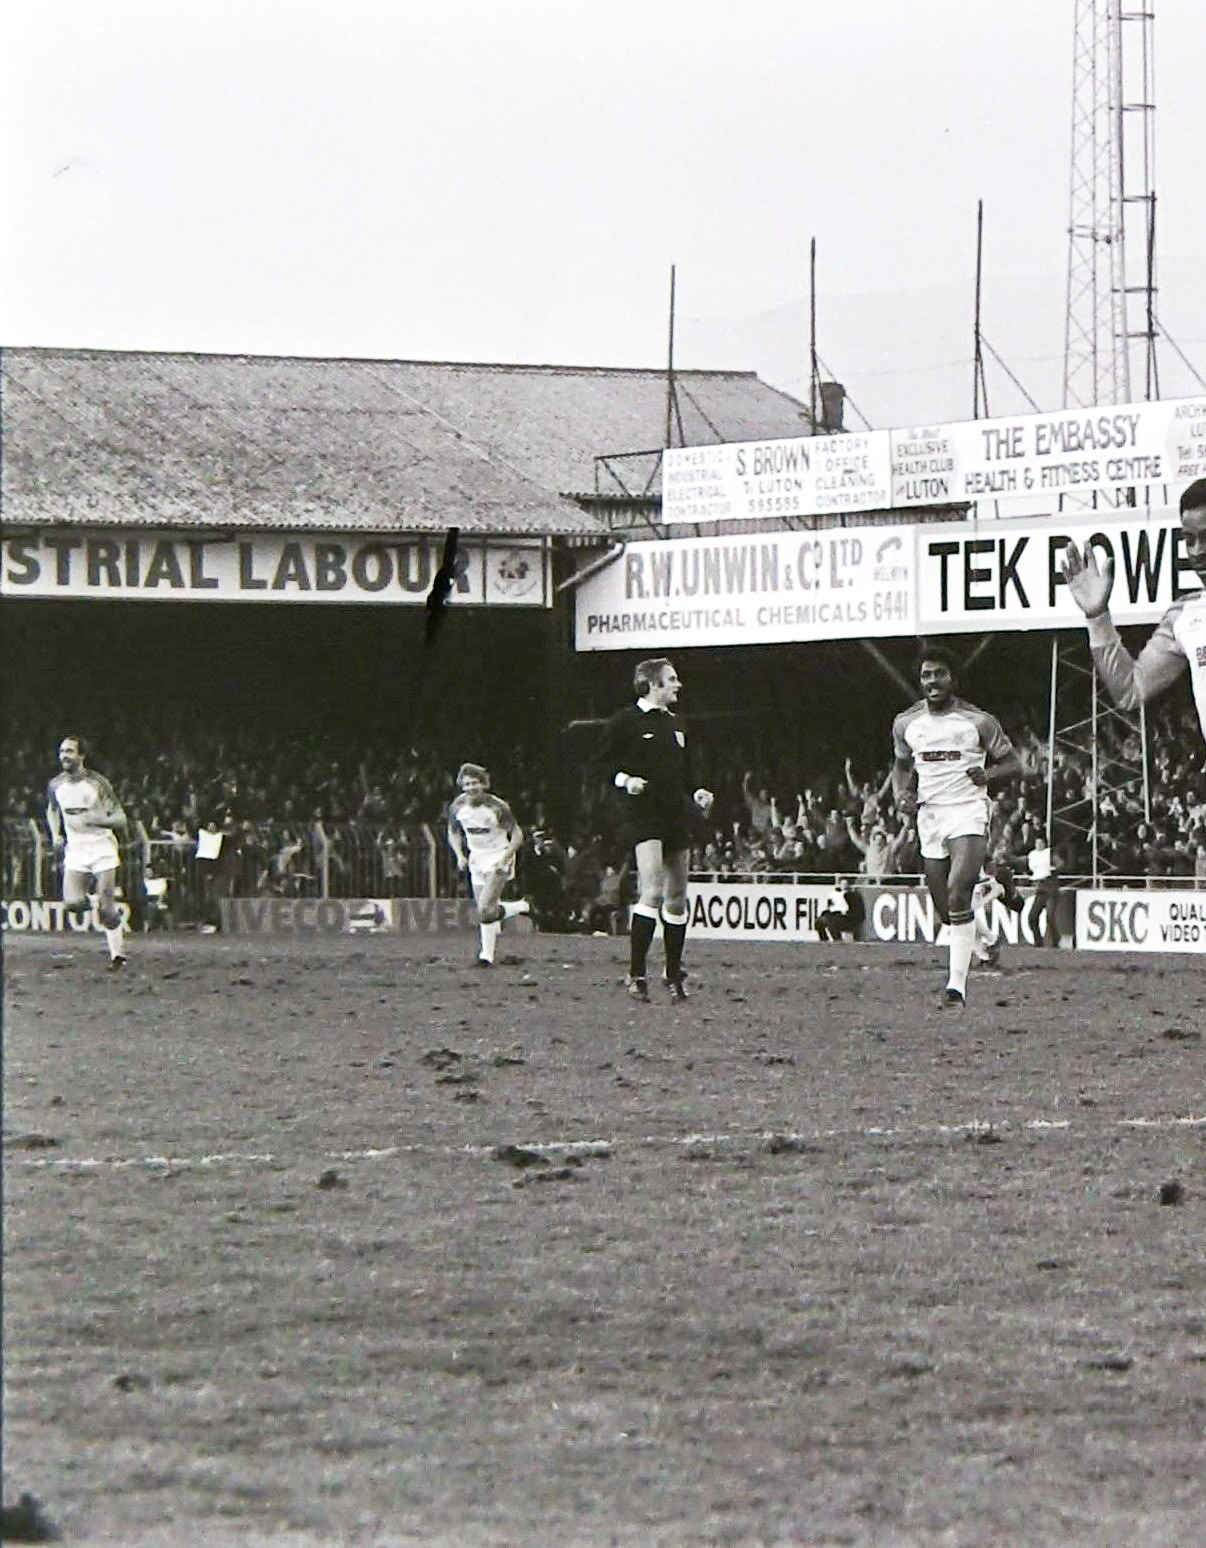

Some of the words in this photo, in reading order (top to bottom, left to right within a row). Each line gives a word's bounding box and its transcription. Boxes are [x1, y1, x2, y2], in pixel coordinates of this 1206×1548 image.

[815, 437, 869, 453] FACTORY
[982, 426, 1025, 461] THE
[1036, 413, 1141, 456] EMBASSY
[736, 449, 747, 476] S
[753, 443, 810, 476] BROWN
[825, 455, 868, 472] OFFICE
[891, 460, 927, 476] HEALTH
[964, 469, 1017, 495] HEALTH
[1023, 467, 1034, 489] &
[1041, 459, 1100, 487] FITNESS
[1106, 455, 1162, 480] CENTRE
[759, 478, 802, 494] LUTON
[815, 473, 875, 490] CLEANING
[906, 478, 949, 500] LUTON
[7, 540, 220, 590] STRIAL
[239, 540, 471, 594] LABOUR
[928, 536, 1030, 612] TEK
[1049, 528, 1205, 607] POWE
[587, 608, 746, 635] PHARMACEUTICAL
[757, 601, 868, 627] CHEMICALS
[873, 591, 908, 621] 6441
[400, 900, 476, 933] IVEC
[686, 894, 787, 931] ACOLOR
[1087, 900, 1149, 943] SKC
[1160, 924, 1199, 943] VIDEO
